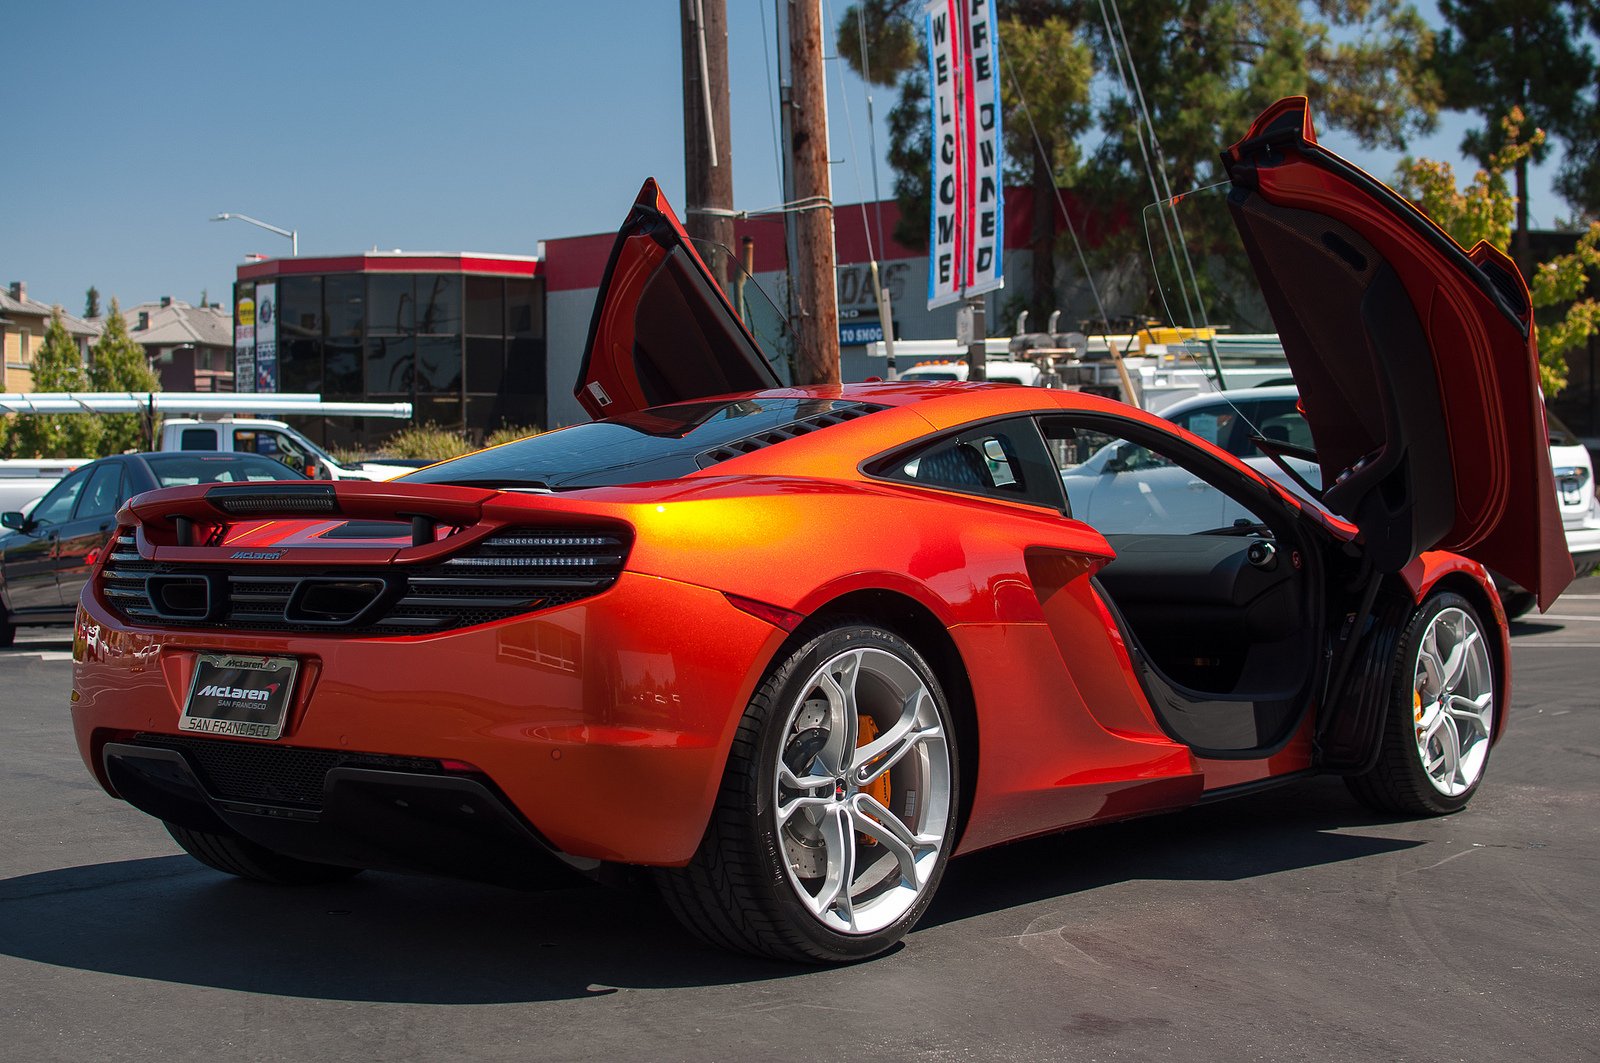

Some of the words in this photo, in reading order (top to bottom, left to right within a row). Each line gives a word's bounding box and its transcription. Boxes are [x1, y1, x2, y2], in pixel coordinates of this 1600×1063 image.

[933, 12, 954, 283] WELCOME
[977, 103, 995, 273] OWNED
[841, 330, 854, 342] TO
[856, 328, 882, 341] SMOG
[230, 551, 280, 560] McLaren
[225, 660, 263, 669] McLaren
[197, 685, 269, 701] McLaren
[232, 701, 267, 710] FRANCISCO
[189, 718, 210, 731] SAN
[212, 721, 270, 737] FRANCISCO
